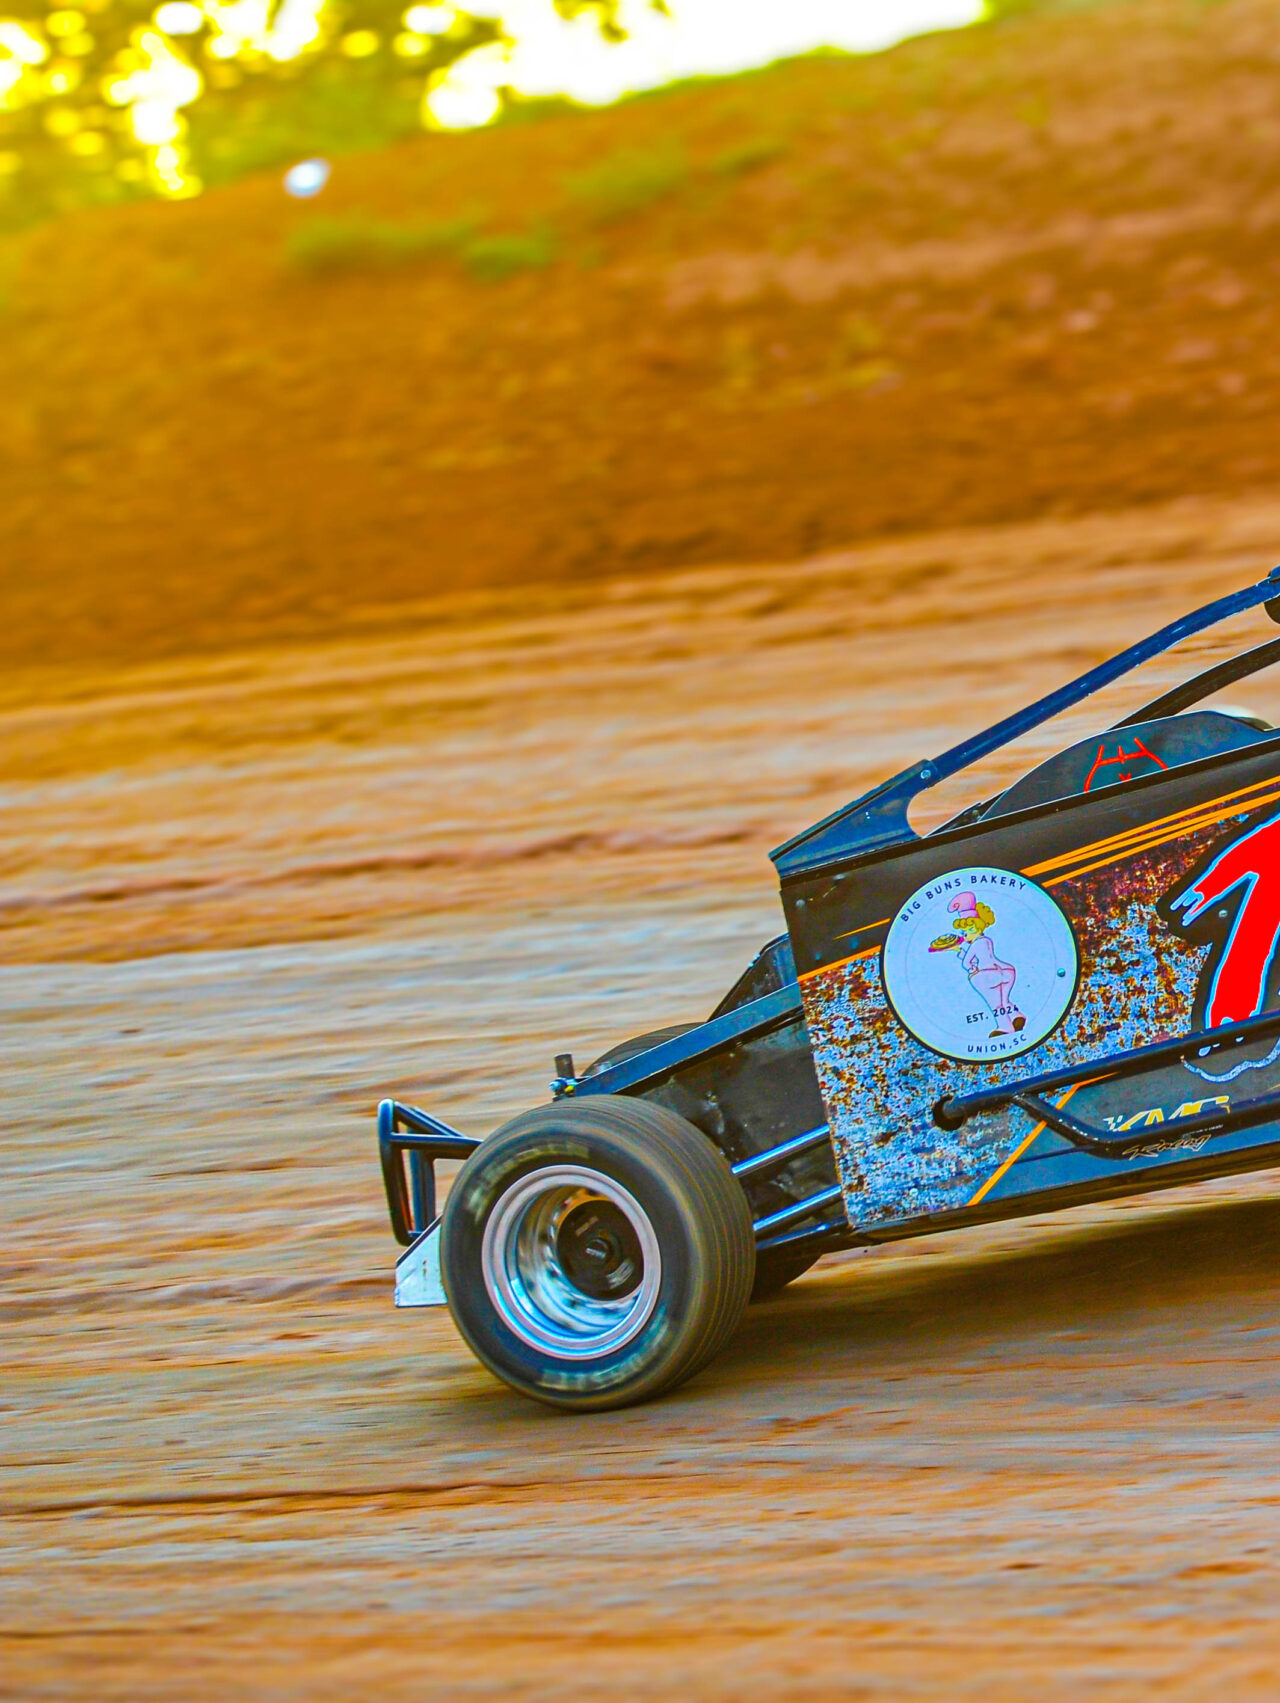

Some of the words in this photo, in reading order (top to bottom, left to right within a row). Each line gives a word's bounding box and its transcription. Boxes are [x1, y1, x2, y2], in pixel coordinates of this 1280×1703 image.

[900, 901, 921, 922] BIG
[926, 878, 962, 900] BUNS
[971, 875, 1027, 891] BAKERY
[966, 1011, 989, 1024] EST.
[993, 1004, 1019, 1018] 2024
